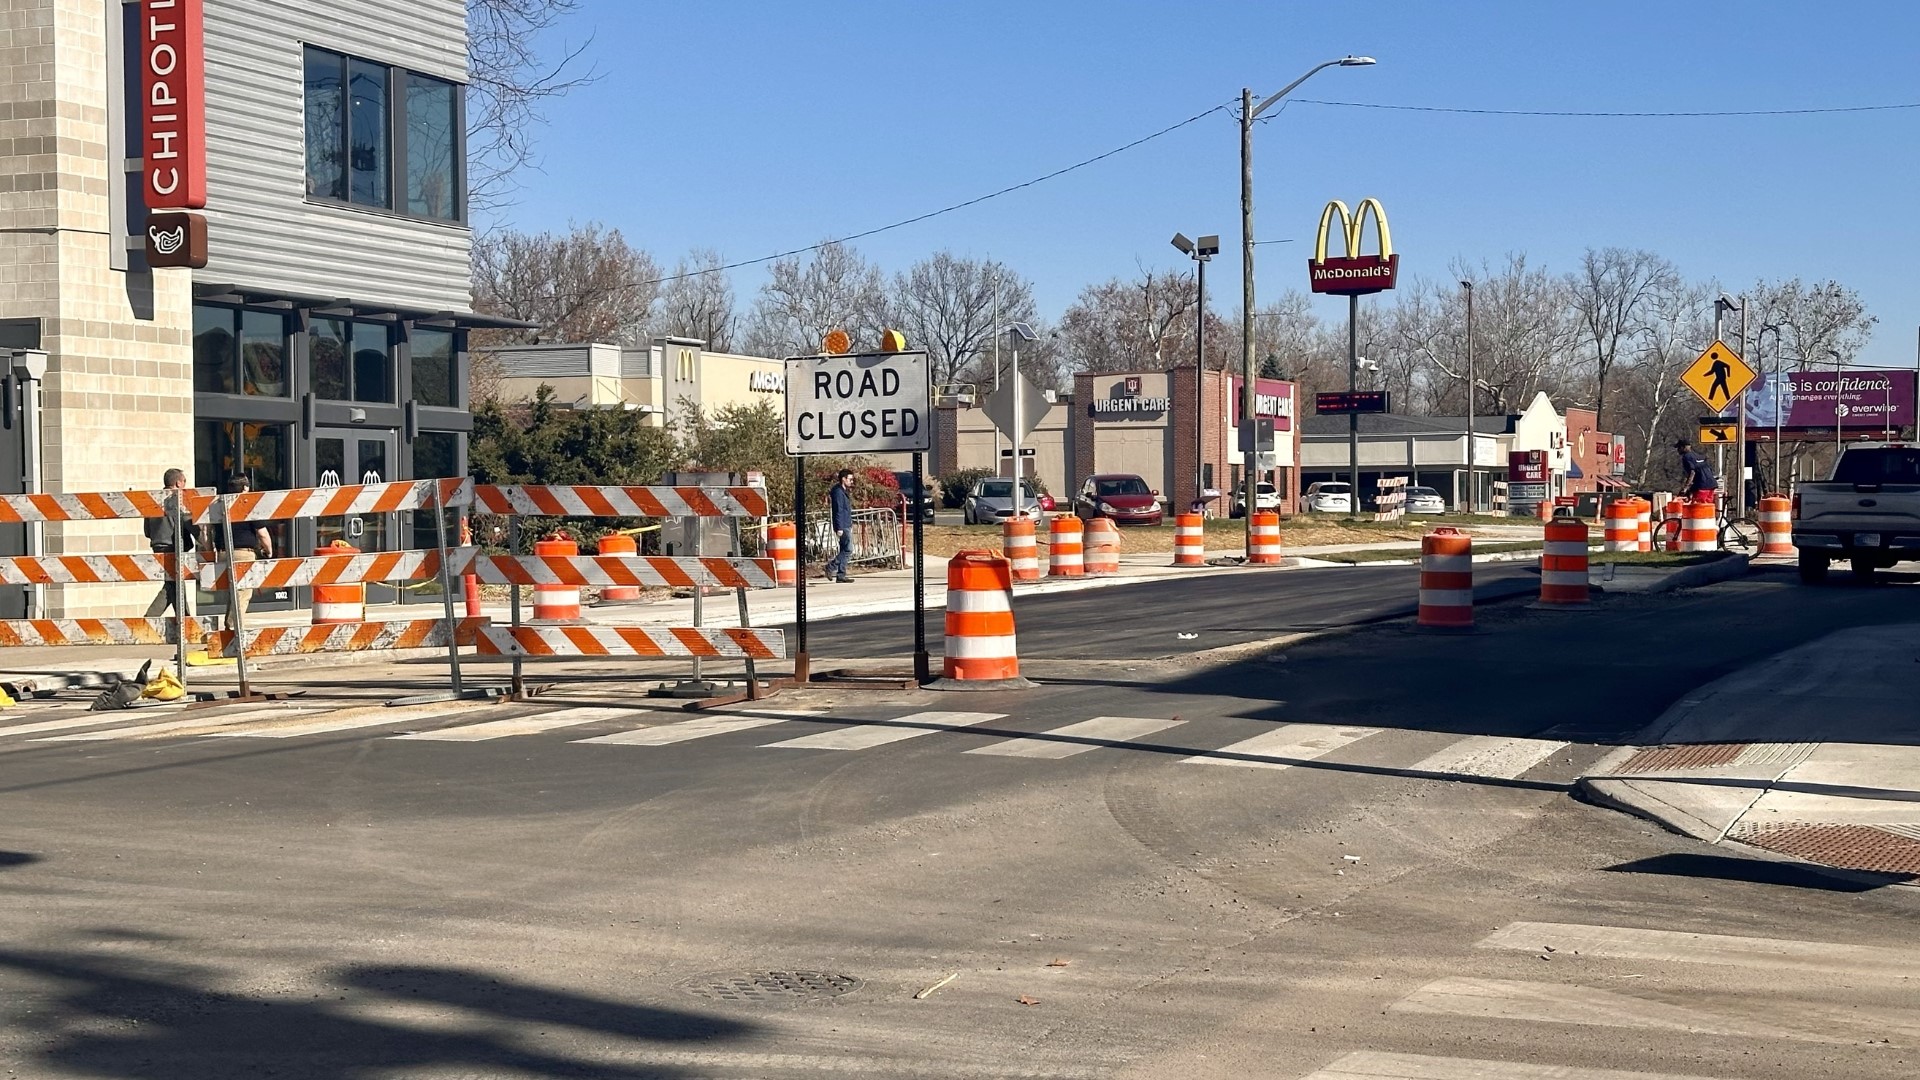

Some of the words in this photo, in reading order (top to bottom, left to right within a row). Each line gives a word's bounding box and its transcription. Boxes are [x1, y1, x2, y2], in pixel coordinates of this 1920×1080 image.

[1314, 266, 1391, 280] McDonald's
[814, 368, 900, 399] ROAD
[1766, 379, 1797, 392] This
[1801, 379, 1813, 392] is
[1815, 377, 1893, 393] confidence.
[1791, 394, 1823, 402] changes
[1823, 393, 1862, 401] everthing.
[1095, 399, 1138, 412] URGENT
[1141, 398, 1171, 411] CARE
[797, 408, 919, 441] CLOSED
[1525, 471, 1542, 479] CARE
